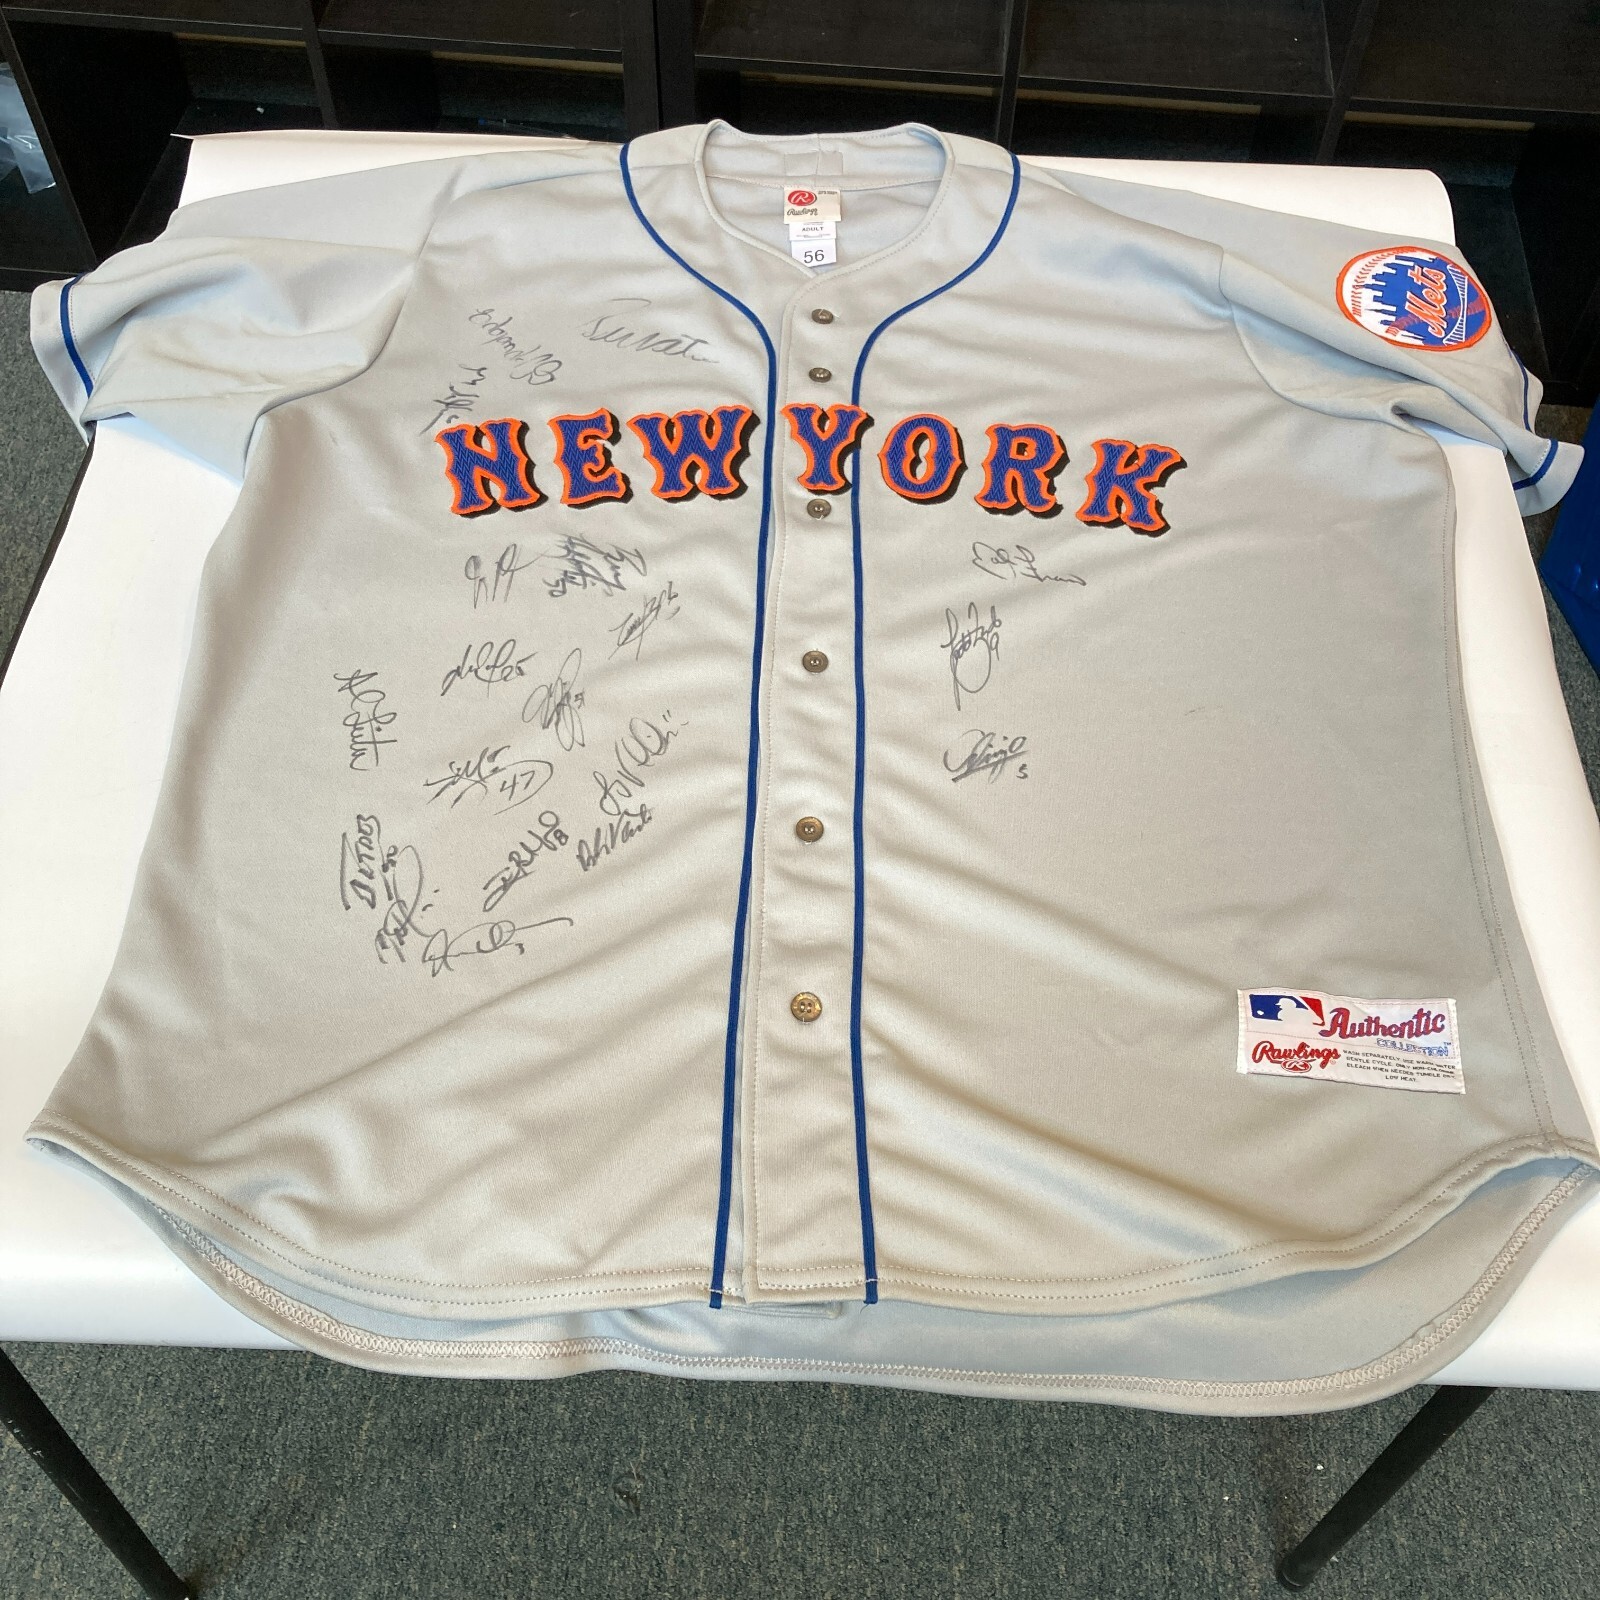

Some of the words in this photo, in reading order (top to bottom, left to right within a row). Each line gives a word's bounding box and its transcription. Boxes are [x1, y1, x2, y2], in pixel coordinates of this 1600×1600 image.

[803, 249, 825, 264] 56
[1404, 264, 1448, 339] Mets
[434, 402, 761, 519] NEW
[780, 402, 1187, 538] YORK
[1318, 1006, 1447, 1040] Authentic
[1251, 1040, 1342, 1070] Rawlings
[1346, 1056, 1370, 1064] GENTLE
